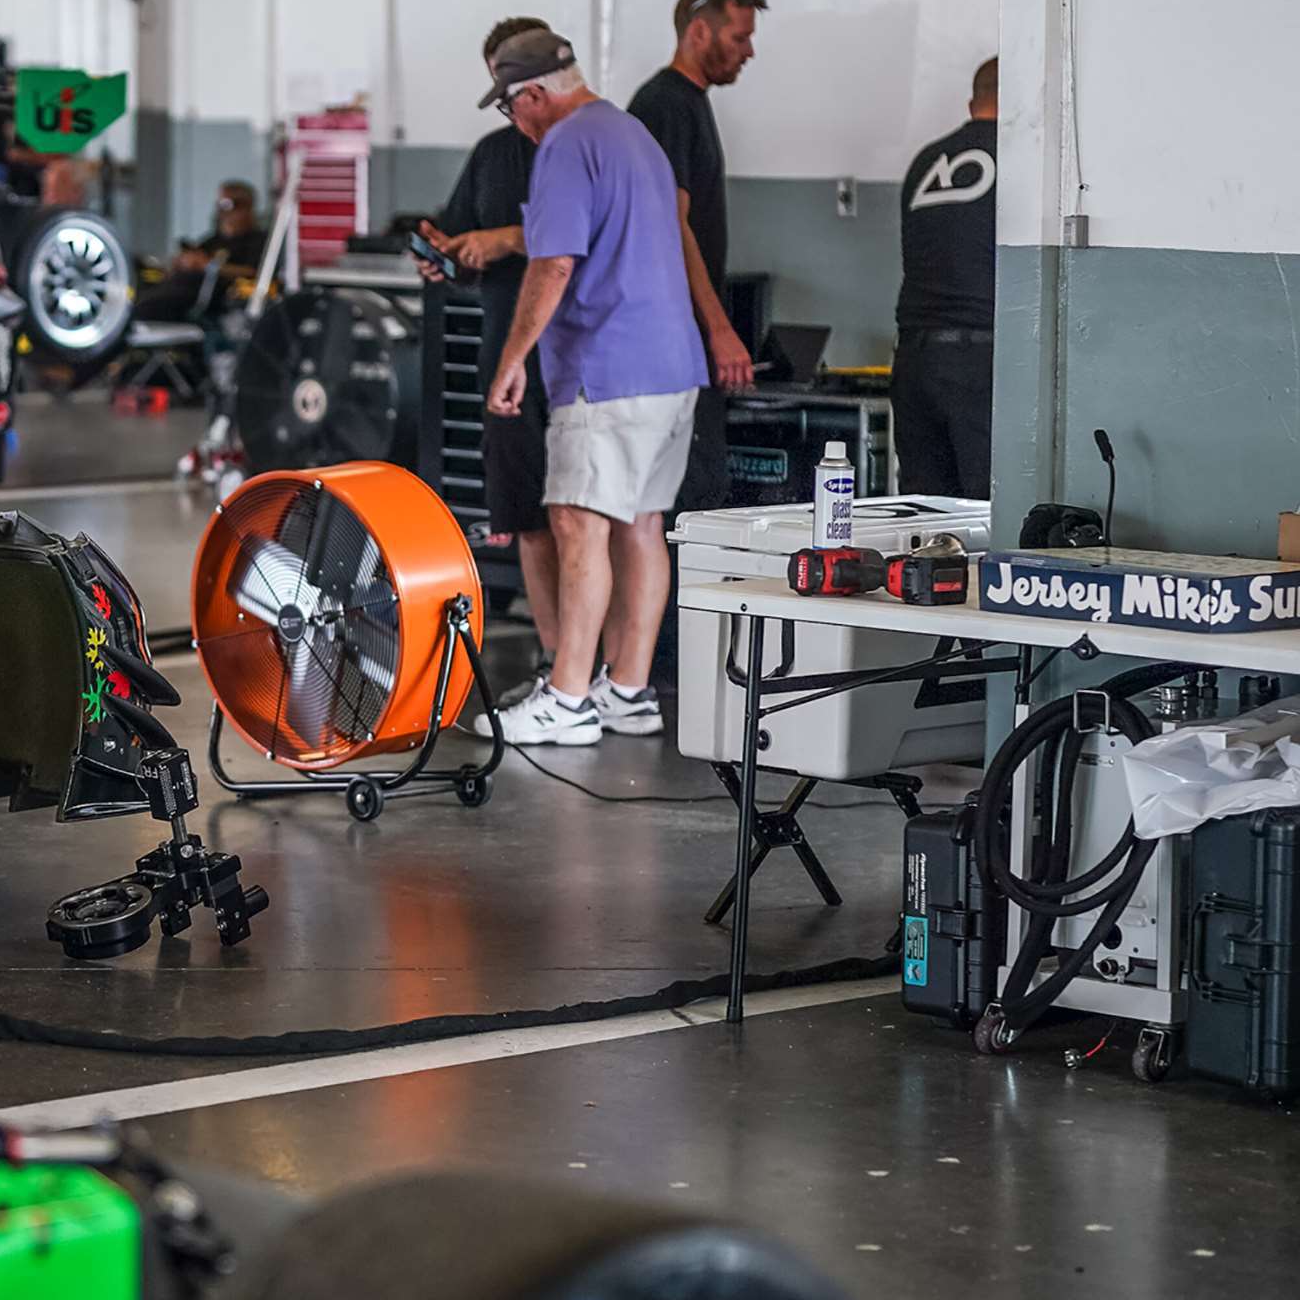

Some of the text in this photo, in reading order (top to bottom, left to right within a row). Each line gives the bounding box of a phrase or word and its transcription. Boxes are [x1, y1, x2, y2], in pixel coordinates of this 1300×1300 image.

[827, 521, 852, 540] cleane
[987, 562, 1112, 623] Jersey
[1120, 574, 1241, 626] Mike's
